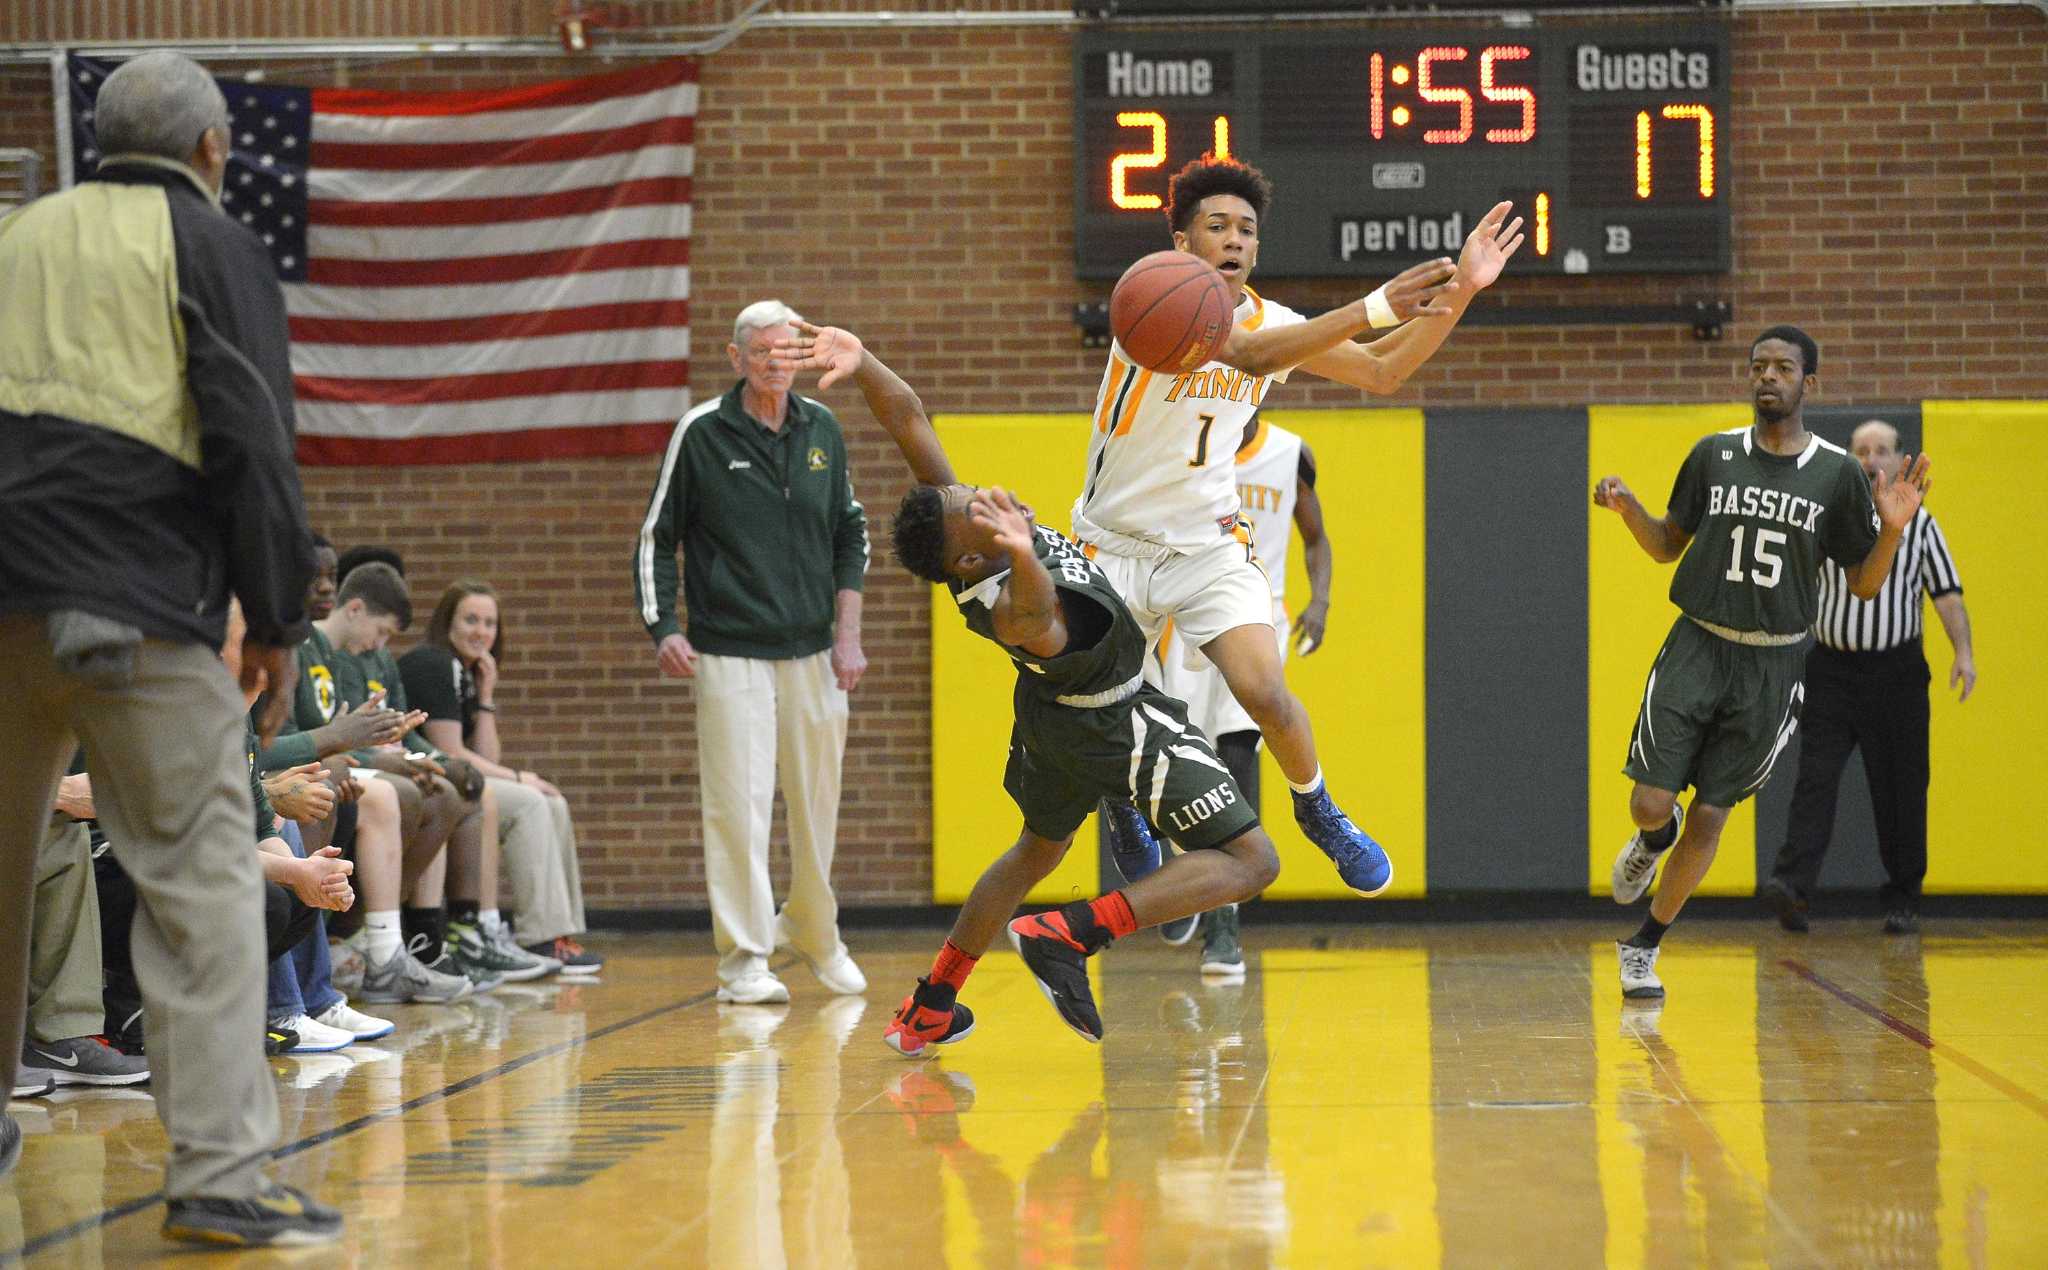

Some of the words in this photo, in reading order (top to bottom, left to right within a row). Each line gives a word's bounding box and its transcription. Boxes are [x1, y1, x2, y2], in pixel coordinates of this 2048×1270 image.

[1107, 51, 1213, 98] Home
[1576, 44, 1710, 91] Guests
[1369, 45, 1537, 145] 1:55
[1635, 104, 1716, 199] 17
[1339, 211, 1463, 262] period
[1534, 191, 1550, 257] 1
[1605, 225, 1631, 254] B
[1188, 413, 1216, 468] 1
[1709, 485, 1825, 533] BASSICK
[1725, 525, 1787, 589] 15
[1169, 782, 1236, 831] LIONS
